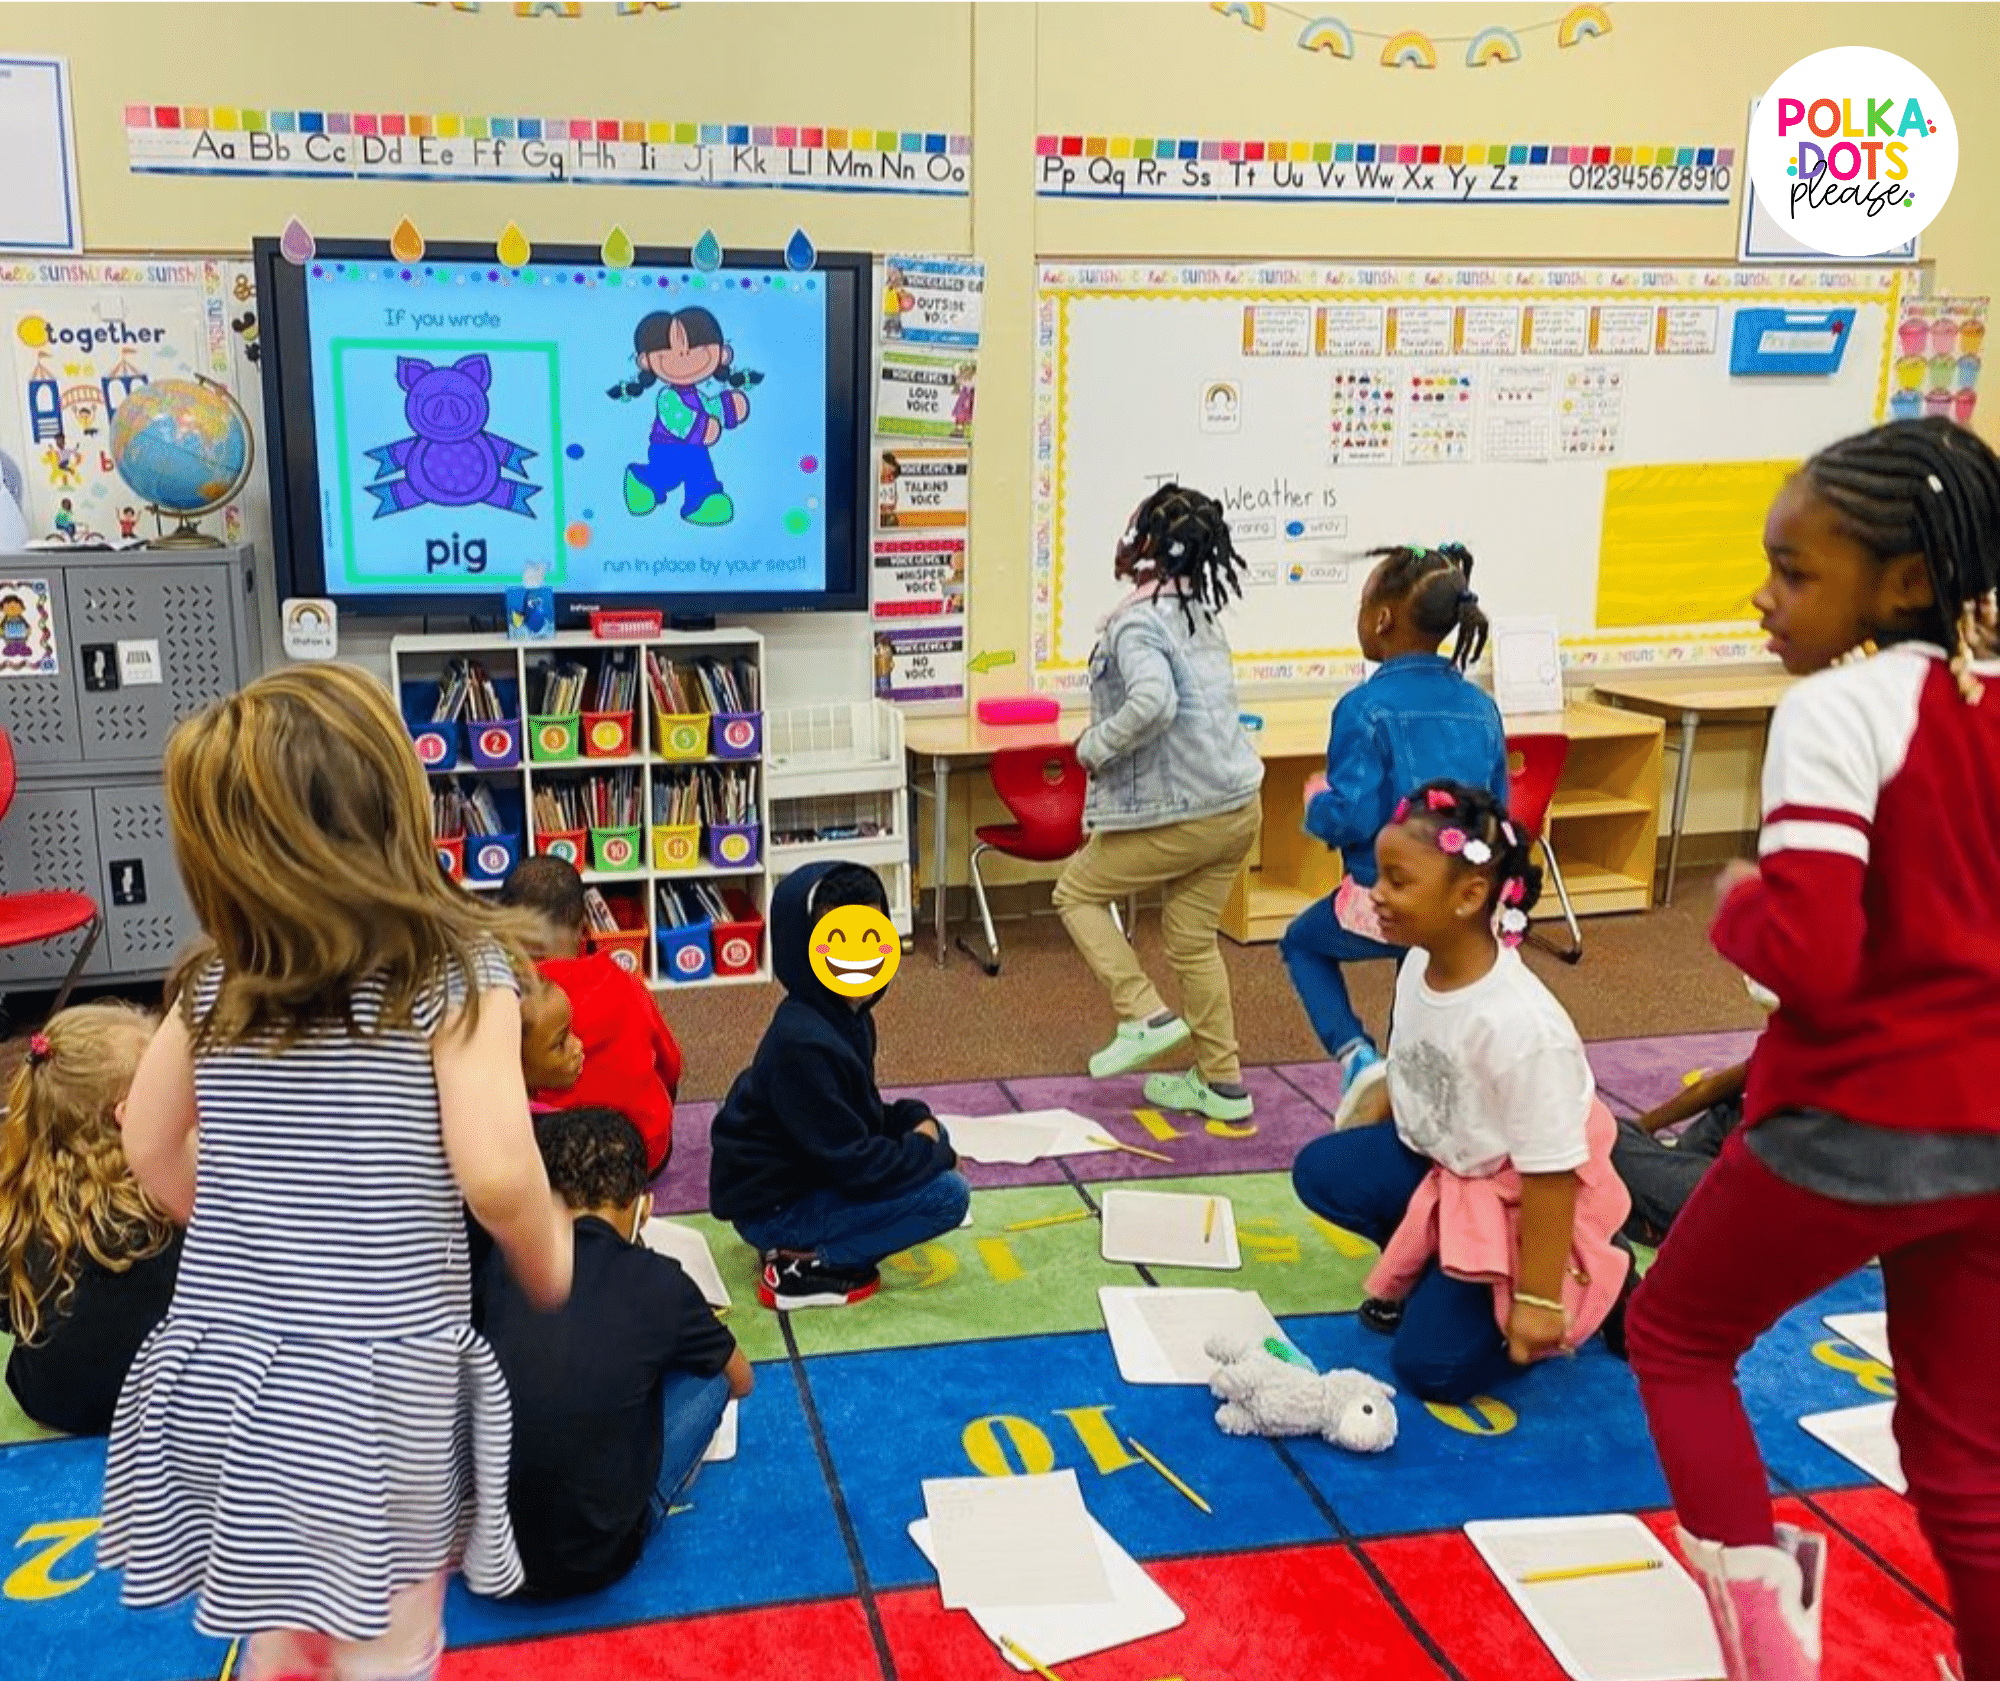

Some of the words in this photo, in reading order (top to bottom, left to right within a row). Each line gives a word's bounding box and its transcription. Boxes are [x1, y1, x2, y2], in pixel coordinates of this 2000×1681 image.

[193, 129, 236, 160] Aa
[250, 131, 291, 162] Bb
[305, 133, 347, 163] Cc
[362, 136, 402, 164] Dd
[419, 137, 454, 166] Ee
[473, 138, 505, 167] Ff
[522, 140, 564, 180] Gg
[577, 143, 616, 170] Hh
[639, 142, 657, 171] Ii
[683, 145, 715, 183] Jj
[732, 147, 767, 174] Kk
[826, 150, 873, 178] Mm
[880, 152, 916, 181] Nn
[926, 154, 966, 182] Oo
[1043, 156, 1076, 194] Pp
[1087, 157, 1126, 197] Qq
[1137, 158, 1167, 185] Rr
[1182, 160, 1211, 187] Ss
[1229, 160, 1256, 187] Tt
[1273, 161, 1304, 188] Uu
[1318, 162, 1346, 188] Vv
[1355, 163, 1394, 189] Ww
[1402, 164, 1435, 191] Xx
[1449, 164, 1477, 200] Yy
[1489, 164, 1519, 191] Zz
[383, 308, 406, 327] If
[410, 313, 445, 331] you
[448, 311, 501, 327] wrote
[45, 320, 166, 353] together
[906, 399, 939, 413] VOICE
[910, 493, 941, 506] VOICE
[426, 532, 487, 573] pig
[603, 559, 632, 573] run
[699, 557, 722, 577] by
[905, 581, 936, 593] VOICE
[912, 656, 928, 667] NO
[904, 667, 935, 680] VOICE
[962, 1404, 1146, 1480] 10
[2, 1517, 103, 1601] 2
